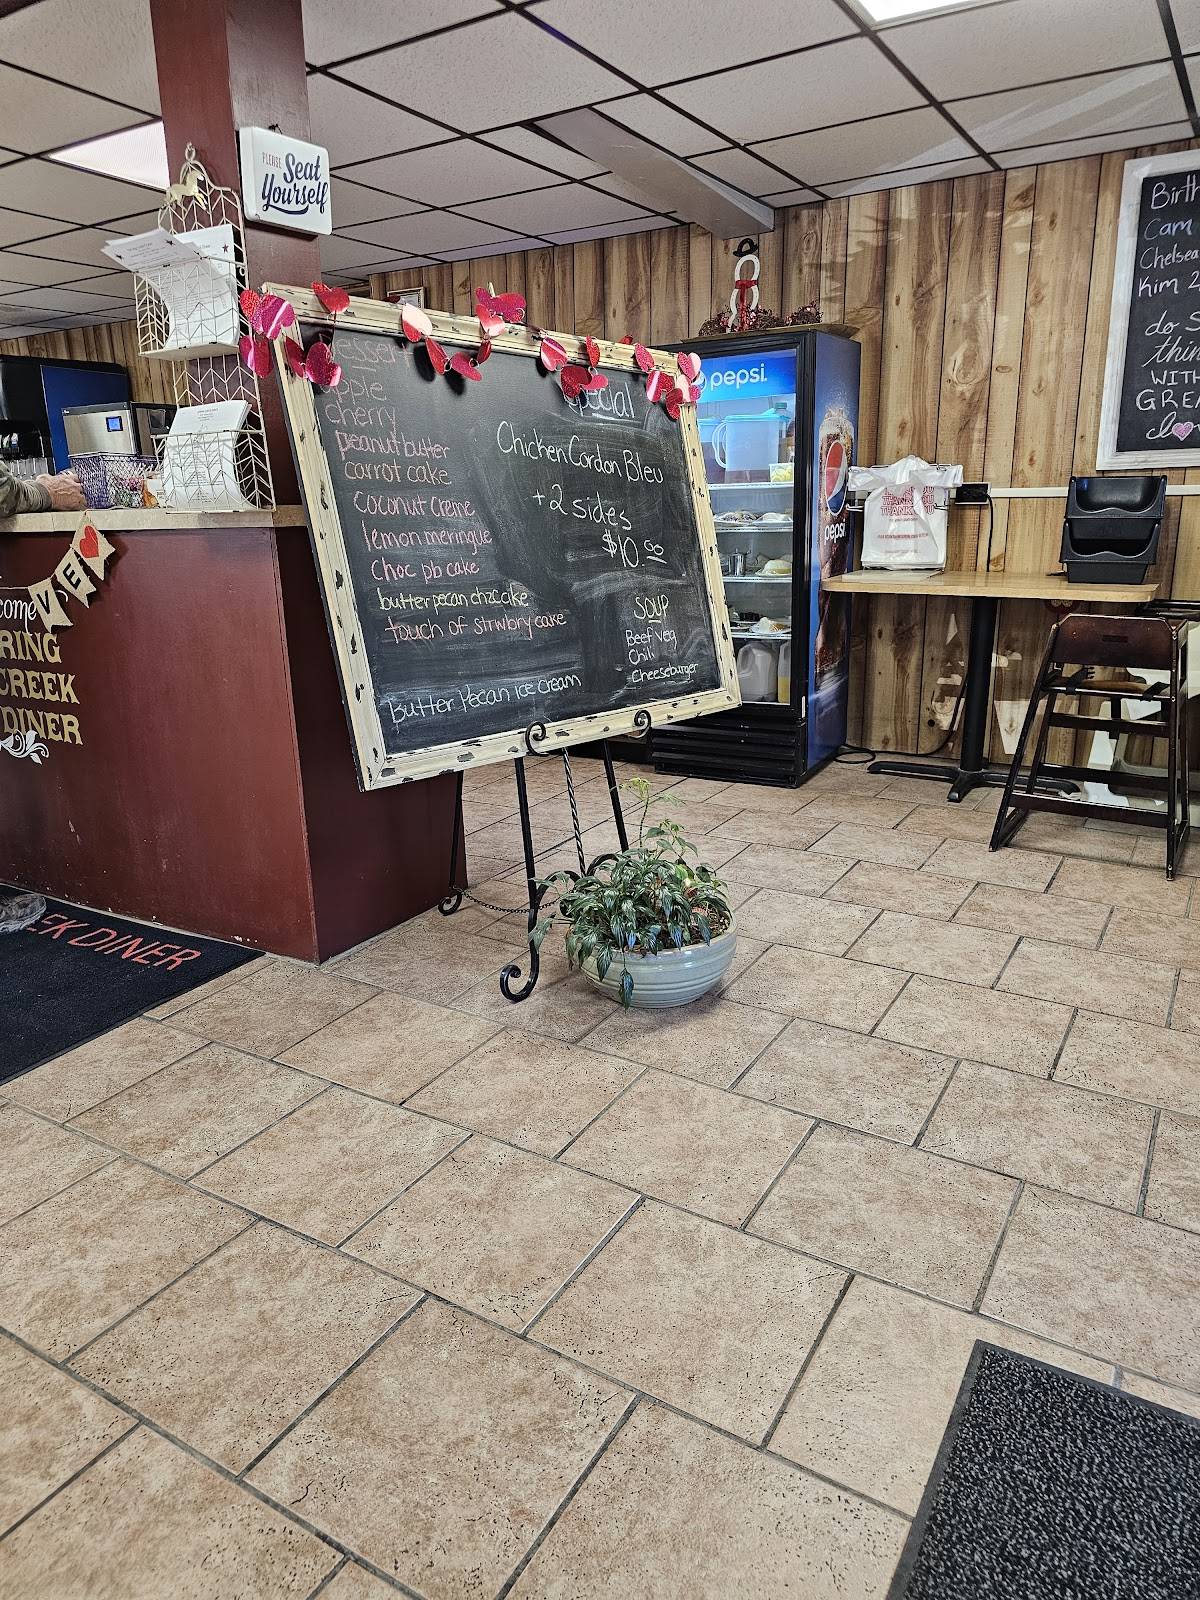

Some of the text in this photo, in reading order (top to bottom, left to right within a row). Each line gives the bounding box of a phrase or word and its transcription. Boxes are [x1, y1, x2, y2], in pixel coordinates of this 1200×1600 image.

[262, 152, 321, 183] PLEASE Seat
[262, 173, 328, 215] Yourself
[1144, 218, 1192, 240] Cam
[1140, 243, 1200, 269] Chelsea
[1138, 276, 1178, 297] Kim
[1143, 310, 1180, 336] do
[710, 363, 767, 391] pepsi
[325, 401, 397, 435] cherry
[335, 430, 450, 460] peanut butter
[497, 421, 664, 483] Chicken Cordon Bleu
[345, 459, 451, 485] carrot cake
[573, 491, 632, 530] sides
[881, 505, 913, 516] THANK
[362, 520, 492, 555] lemon meringue
[824, 518, 846, 545] pepsi
[422, 560, 442, 584] pb
[447, 557, 479, 576] cake
[377, 587, 429, 610] butter
[432, 593, 468, 616] pecan
[634, 594, 669, 619] SOUP
[385, 616, 443, 643] touch
[449, 616, 468, 635] of
[535, 613, 567, 629] cake
[626, 627, 653, 647] Beef
[628, 646, 655, 665] Chili
[632, 662, 698, 682] Cheeseburger
[387, 695, 456, 724] Butter
[459, 685, 510, 712] Pecan
[0, 705, 83, 745] DINER
[67, 928, 201, 970] DINER
